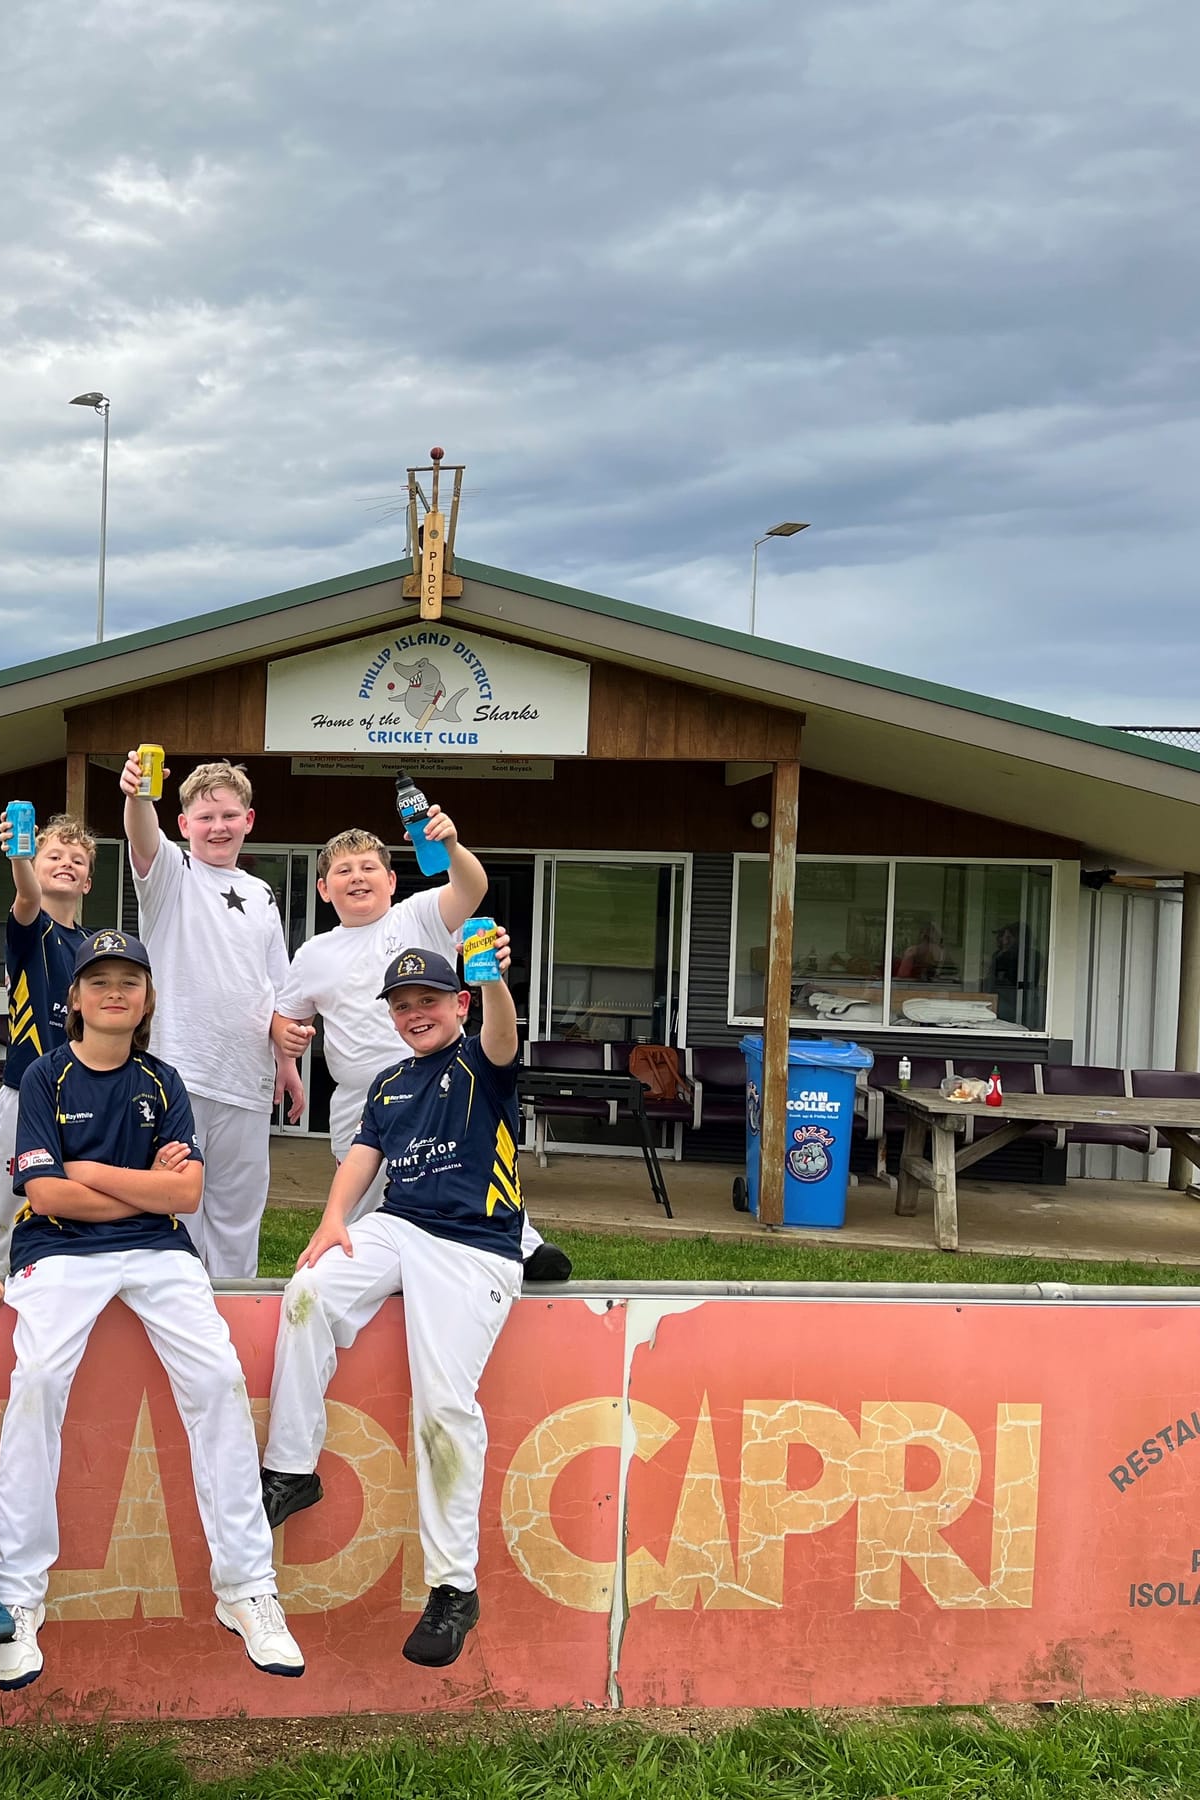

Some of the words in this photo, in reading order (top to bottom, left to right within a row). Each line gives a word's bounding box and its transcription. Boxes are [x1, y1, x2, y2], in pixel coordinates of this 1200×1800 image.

[358, 647, 392, 699] PHILLIP
[394, 632, 451, 652] ISLAND
[452, 641, 493, 701] DISTRICT
[310, 713, 354, 728] Home
[359, 712, 375, 730] of
[379, 711, 401, 726] the
[473, 703, 540, 722] Sharks
[367, 730, 433, 744] CRICKET
[438, 732, 479, 745] CLUB
[398, 792, 426, 809] POWER
[799, 1091, 828, 1102] CAN
[786, 1100, 841, 1113] COLLECT
[389, 1154, 420, 1169] AINT
[501, 1388, 1042, 1614] CAPRI
